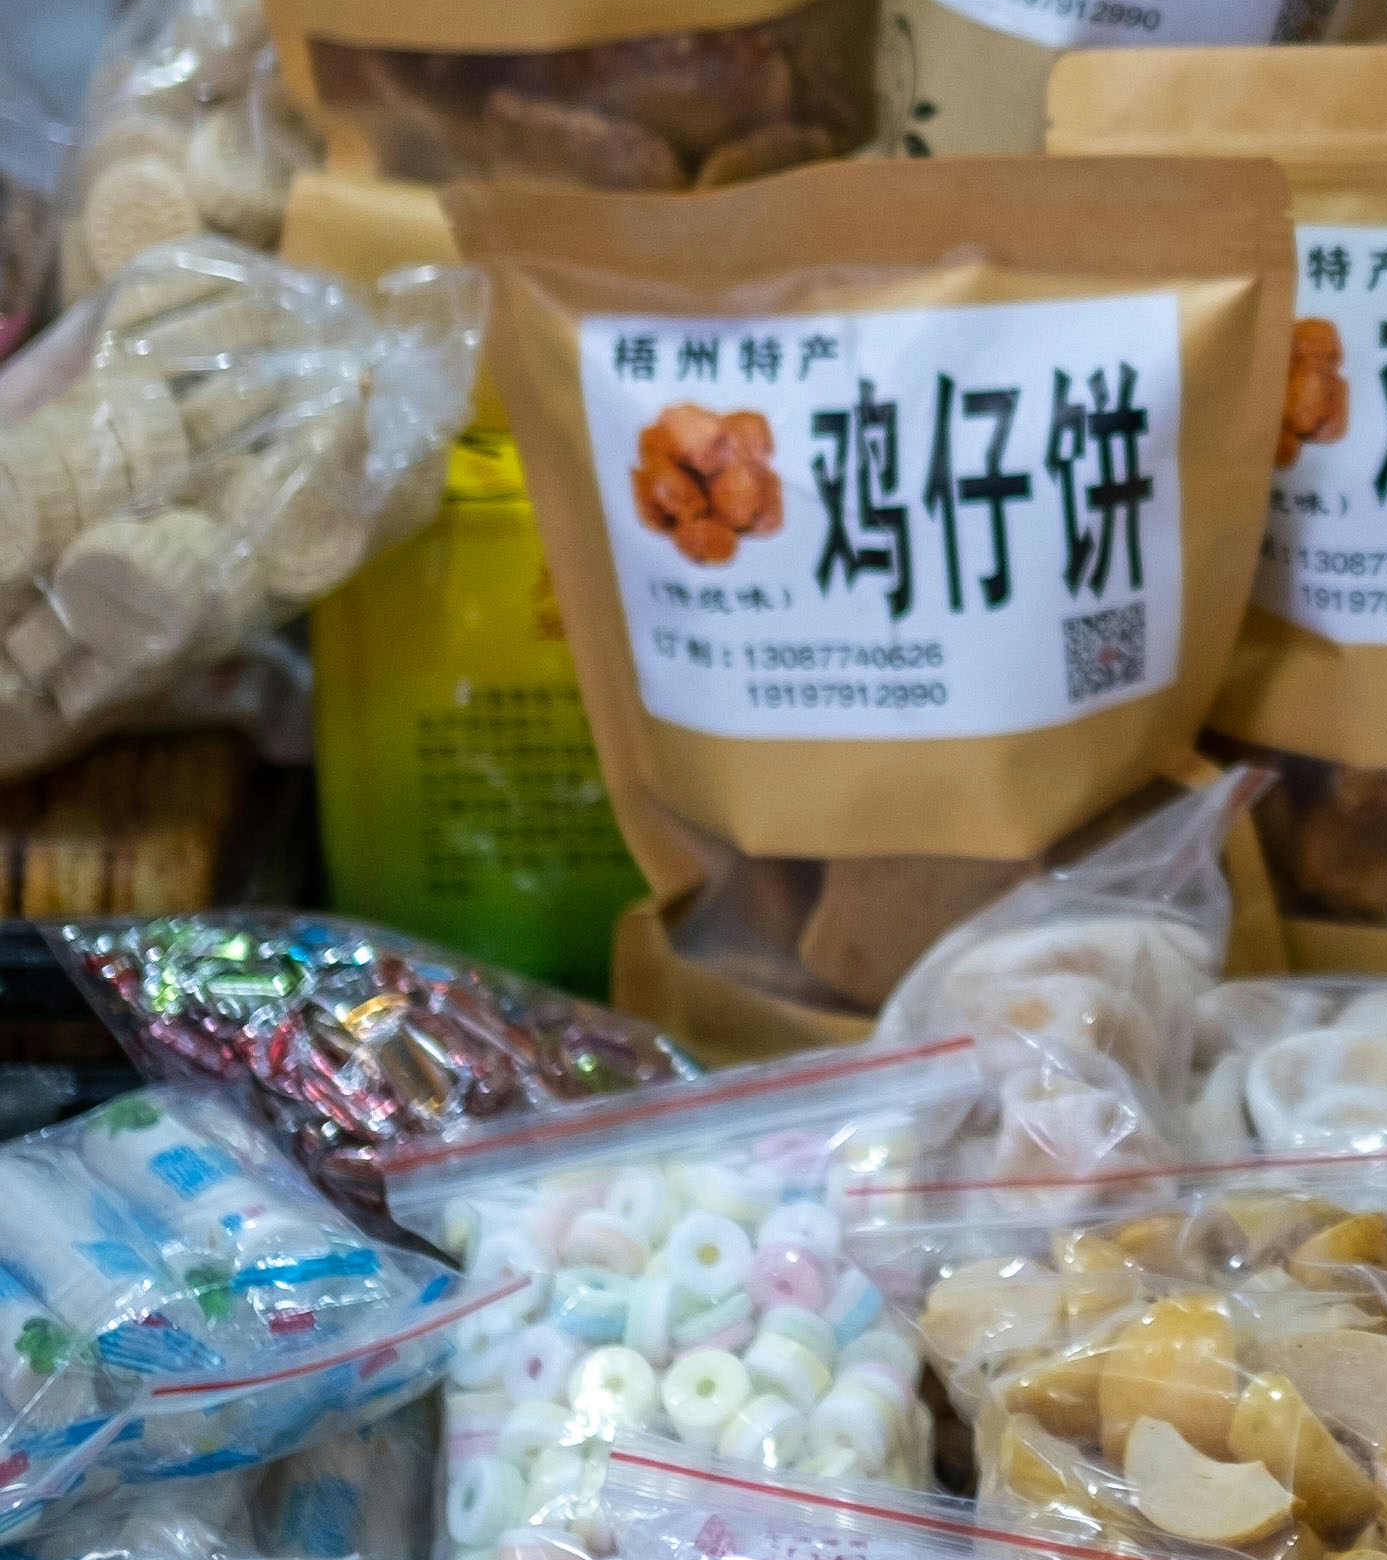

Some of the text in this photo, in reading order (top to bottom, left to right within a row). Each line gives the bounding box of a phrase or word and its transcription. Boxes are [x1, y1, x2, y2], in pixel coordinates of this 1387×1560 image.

[612, 331, 840, 384] 梧州特产
[810, 358, 1155, 623] 鸡仔饼
[746, 678, 950, 710] 19197912990
